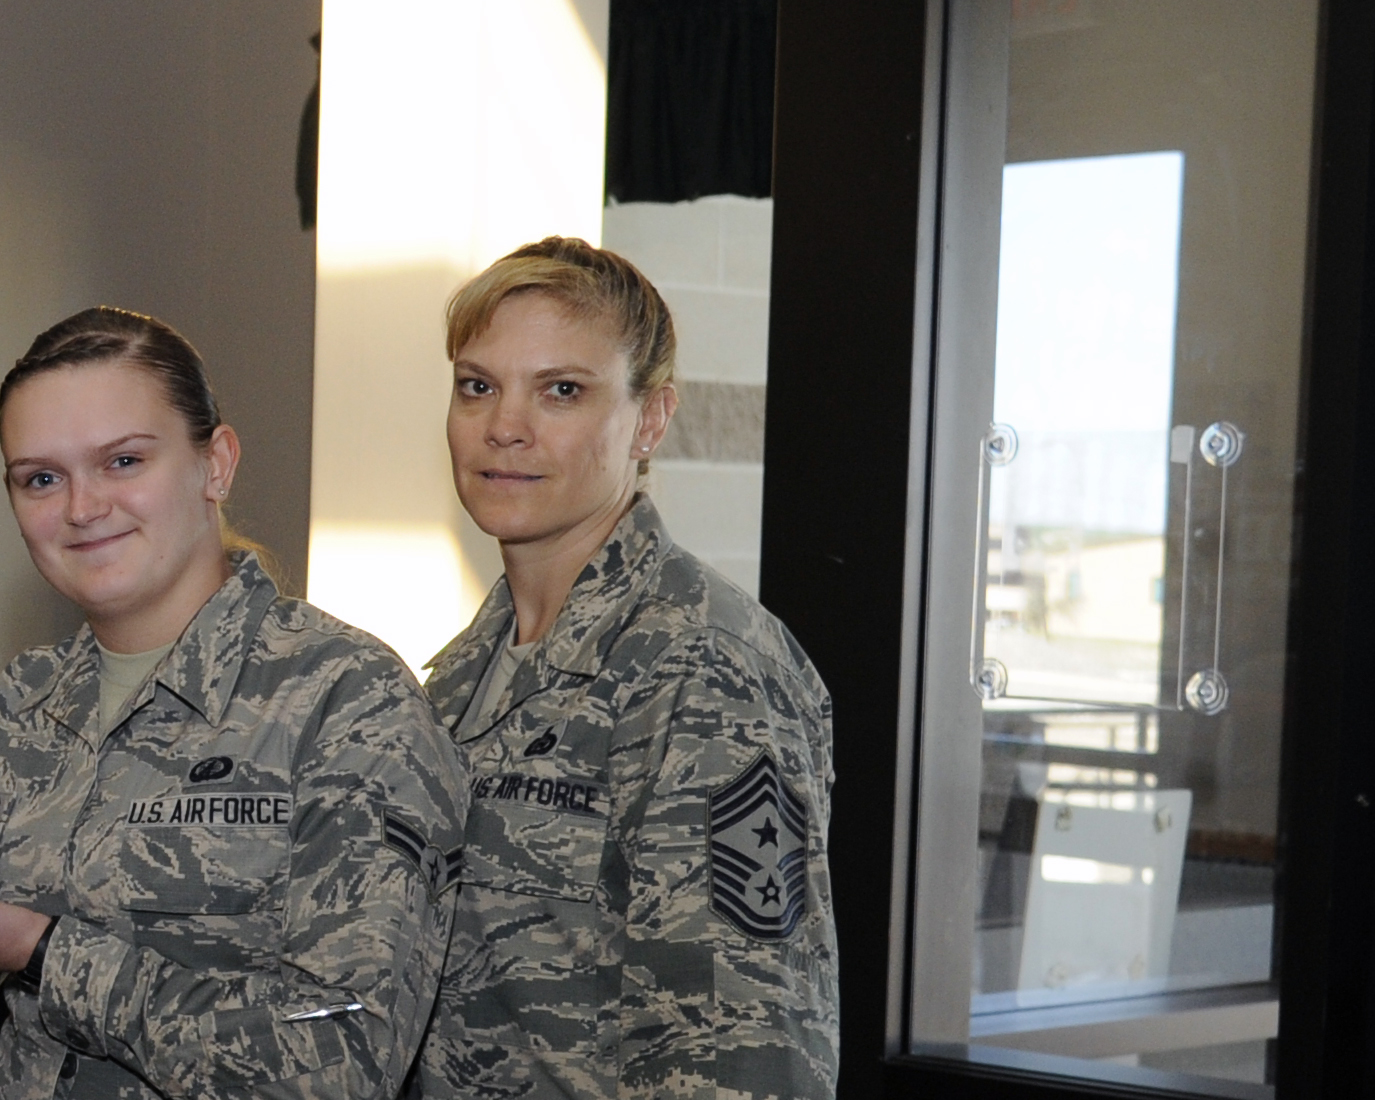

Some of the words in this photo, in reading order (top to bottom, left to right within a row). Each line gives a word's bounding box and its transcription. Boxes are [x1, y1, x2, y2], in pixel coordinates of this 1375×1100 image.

[492, 775, 523, 800] AIR
[524, 776, 598, 813] FORCE
[128, 801, 164, 824] U.S.
[169, 798, 205, 824] AIR
[209, 797, 289, 824] FORCE
